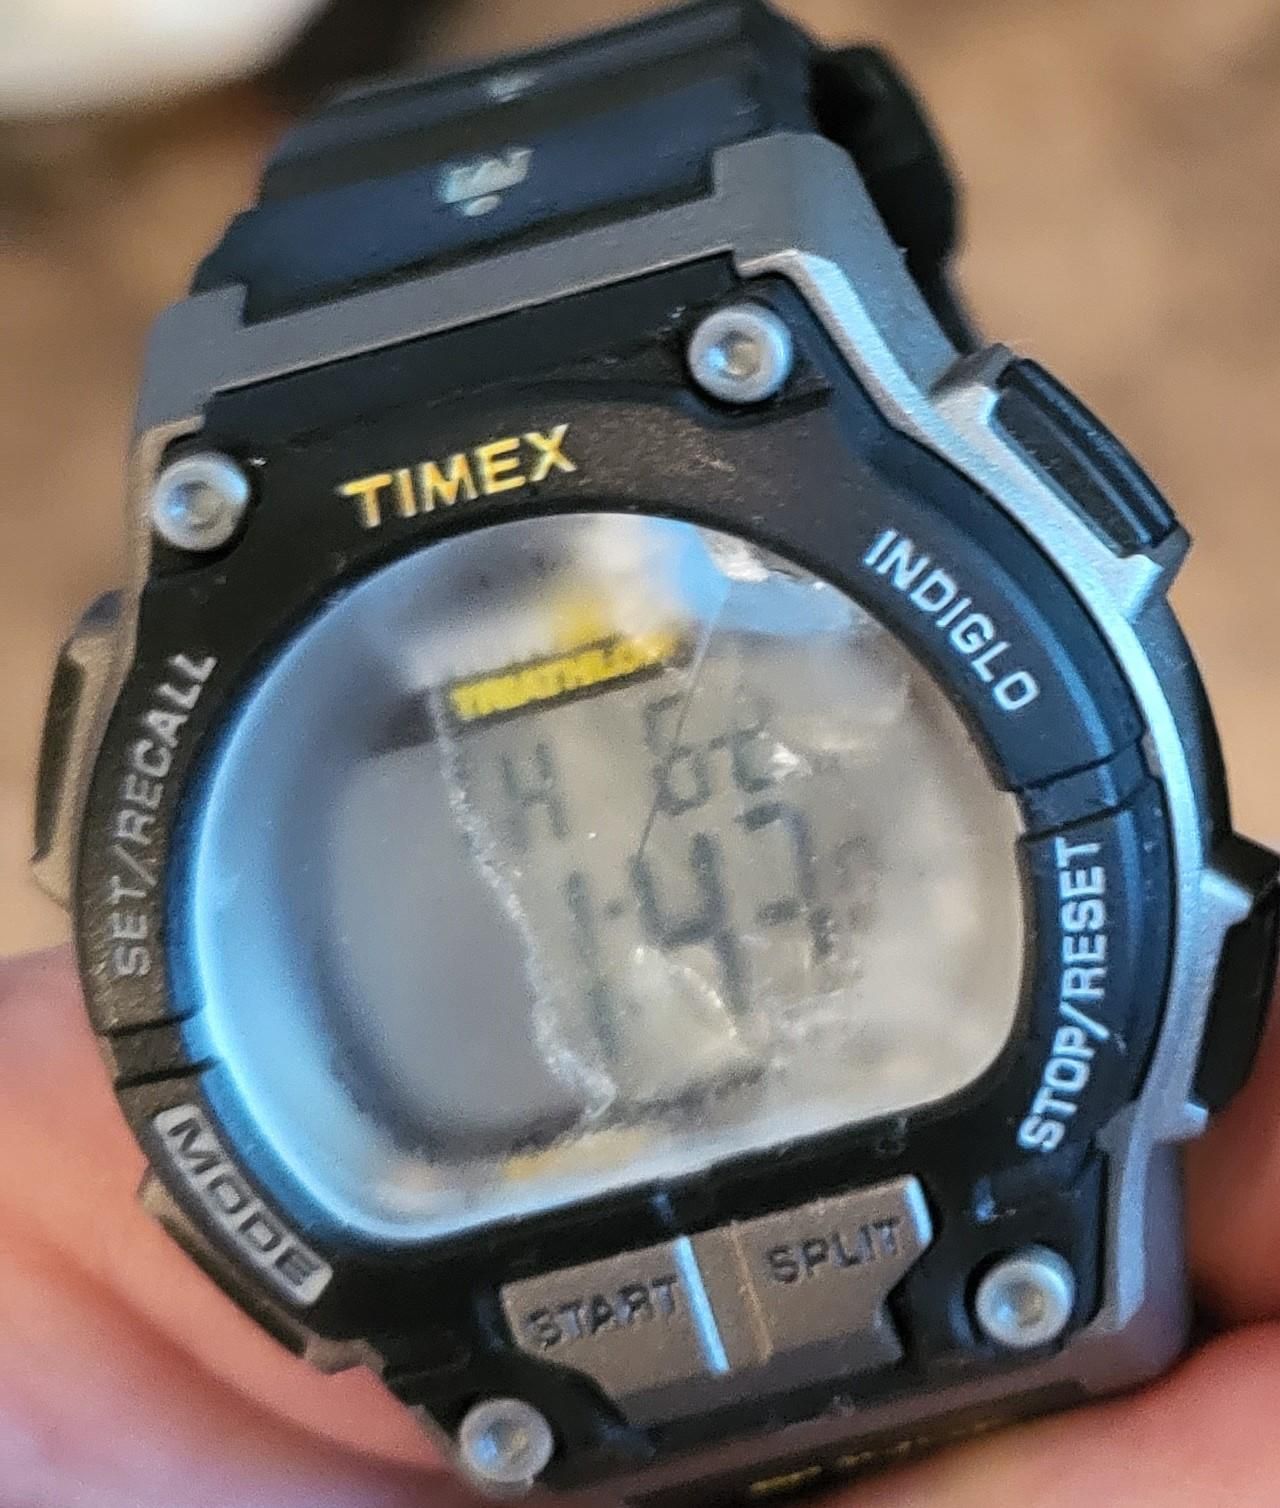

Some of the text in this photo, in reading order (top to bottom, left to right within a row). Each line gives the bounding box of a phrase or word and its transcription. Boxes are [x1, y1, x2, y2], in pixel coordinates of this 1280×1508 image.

[338, 424, 578, 529] TIMEX
[864, 527, 1041, 712] INDIGLO
[107, 653, 219, 978] SET/RECALL
[1017, 836, 1111, 1154] STOP/RESET
[164, 1114, 319, 1293] MODE
[526, 1215, 902, 1353] START SPLIT
